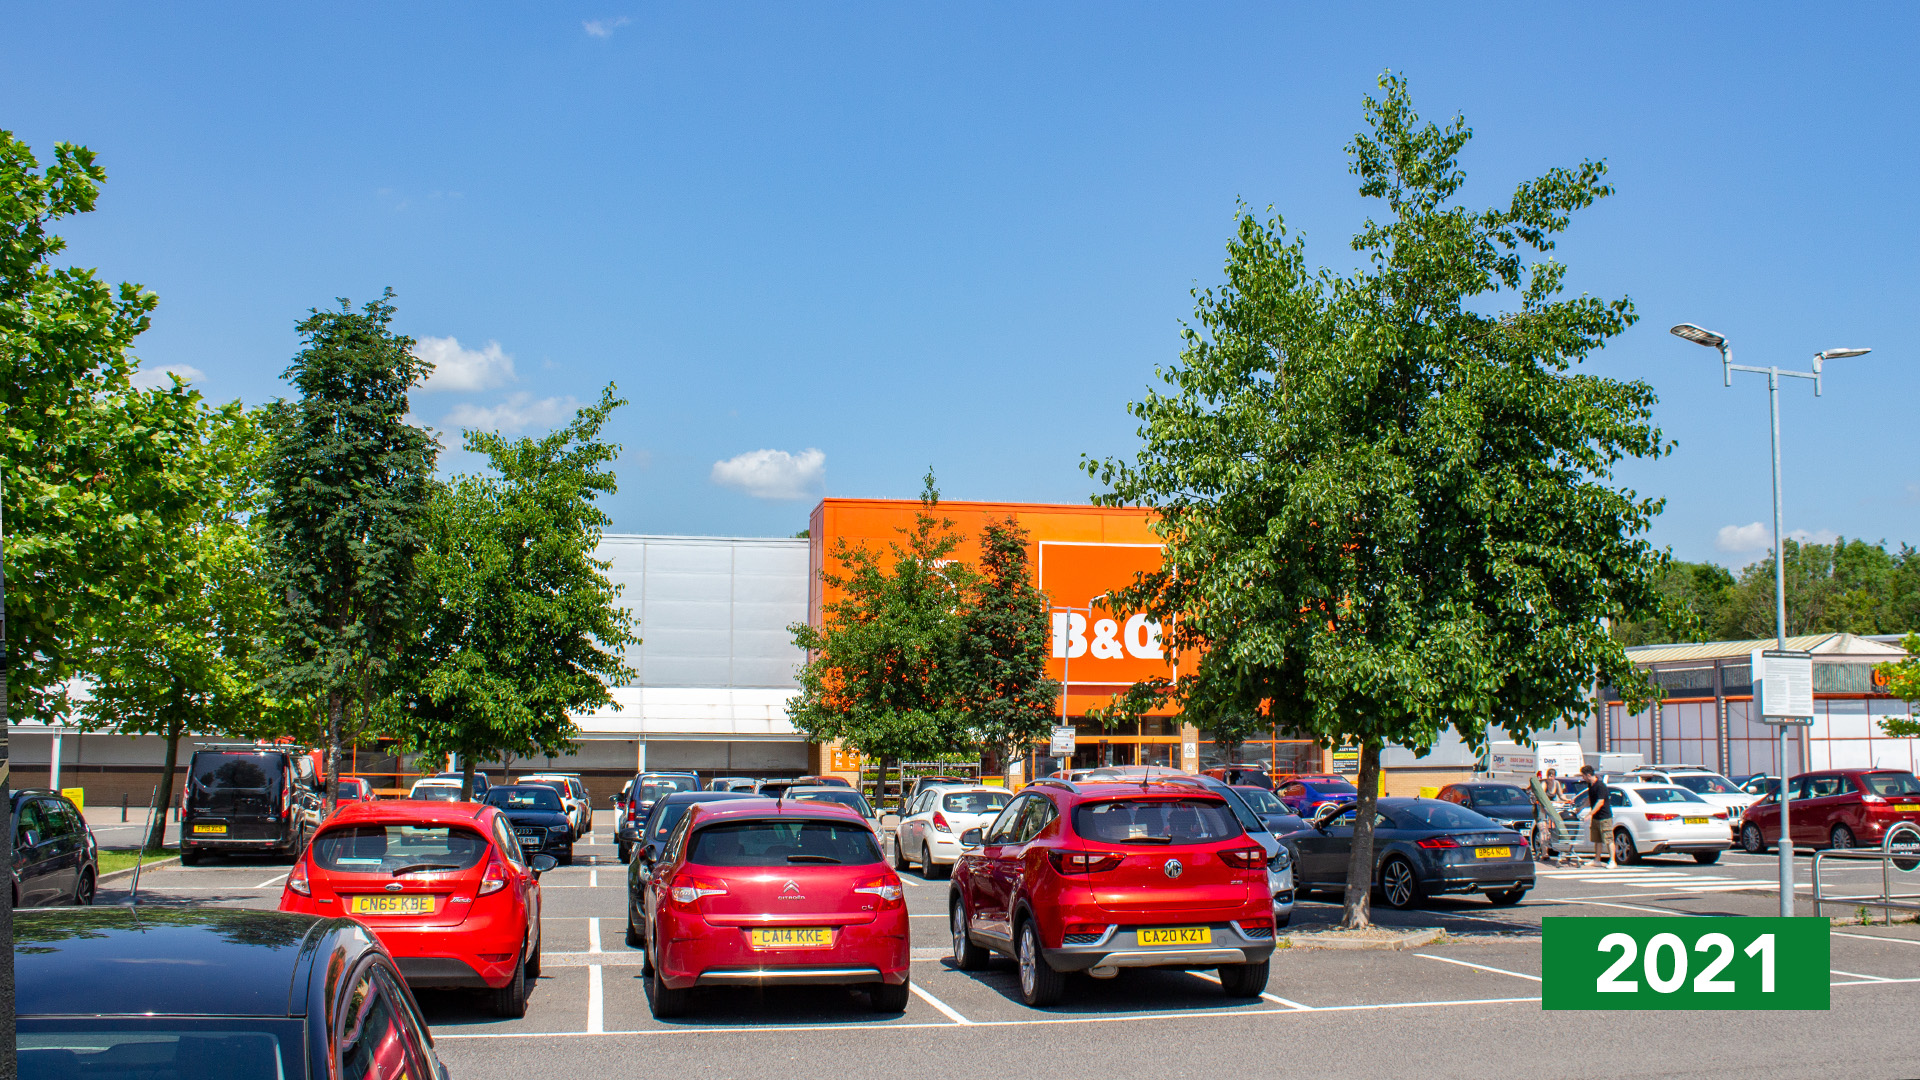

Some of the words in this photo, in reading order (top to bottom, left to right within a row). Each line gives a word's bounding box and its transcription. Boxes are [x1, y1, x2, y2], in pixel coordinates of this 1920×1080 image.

[1052, 612, 1165, 660] B&Q
[1543, 757, 1557, 765] Days
[360, 898, 397, 911] CN65
[401, 898, 429, 911] KBE
[762, 929, 793, 943] CA14
[796, 929, 824, 942] KKE
[1143, 929, 1177, 943] CA20
[1180, 928, 1205, 941] KZT
